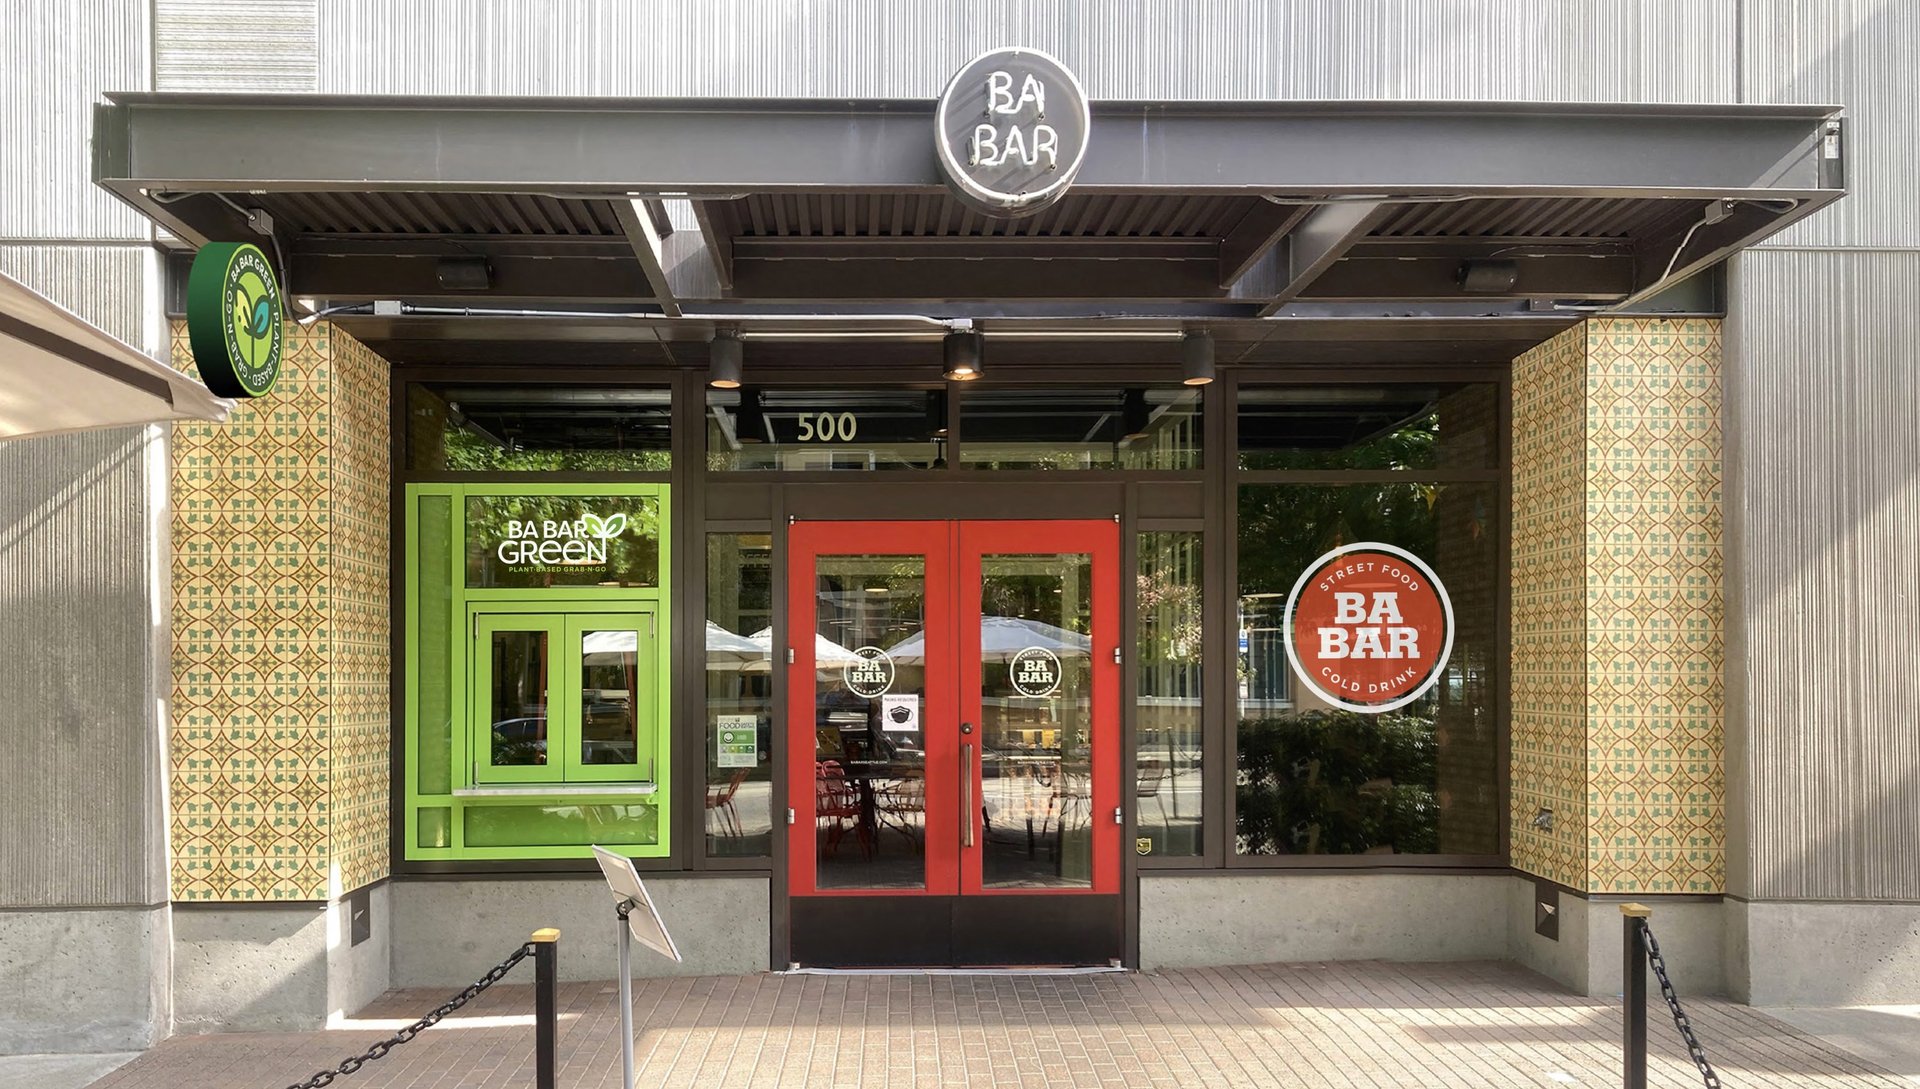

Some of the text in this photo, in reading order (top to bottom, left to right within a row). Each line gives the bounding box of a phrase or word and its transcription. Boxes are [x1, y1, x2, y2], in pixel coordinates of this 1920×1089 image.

[988, 71, 1045, 114] BA
[973, 124, 1058, 166] BAR
[231, 254, 275, 300] BA BAR GREEN
[252, 311, 280, 387] PLANT-BASED
[797, 411, 857, 442] 500
[508, 520, 590, 539] BA BAR
[1320, 562, 1419, 592] STREET FOOD
[1334, 592, 1403, 624] BA
[1317, 627, 1420, 659] BAR
[852, 671, 887, 683] BAR
[857, 660, 881, 671] BA
[1018, 672, 1054, 683] BAR
[1023, 660, 1047, 671] BA
[853, 684, 885, 694] COLD DRINK
[1019, 684, 1052, 695] COLD DRINK
[1321, 666, 1417, 693] COLD DRINK
[719, 722, 741, 730] FOOD
